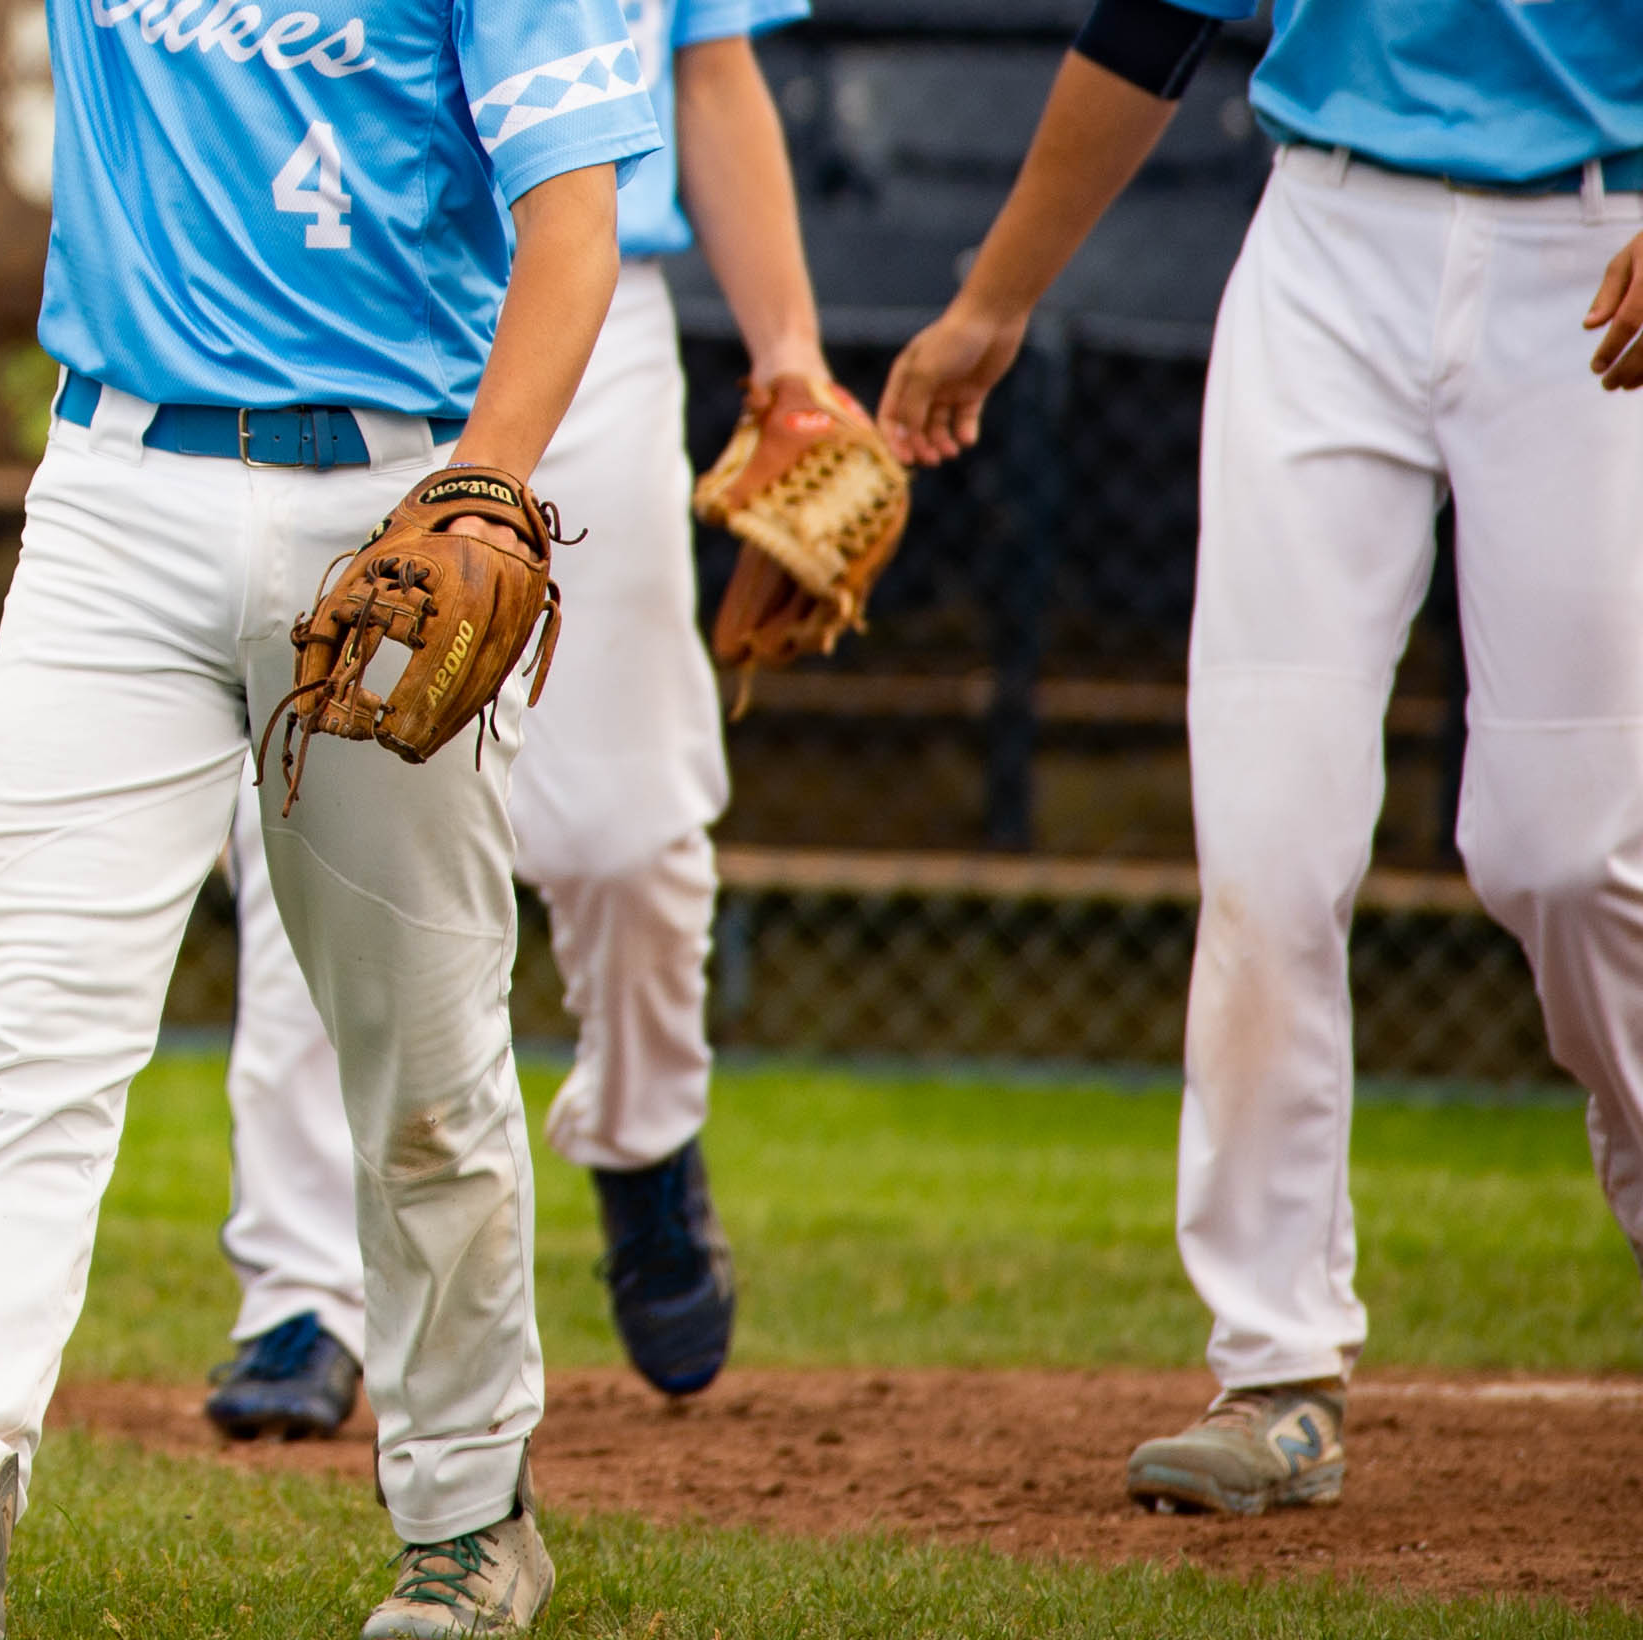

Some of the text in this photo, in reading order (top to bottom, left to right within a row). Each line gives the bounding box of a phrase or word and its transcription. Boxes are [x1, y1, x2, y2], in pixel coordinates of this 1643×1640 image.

[272, 120, 351, 249] 4
[426, 481, 515, 505] Wilson
[426, 620, 474, 709] A2000
